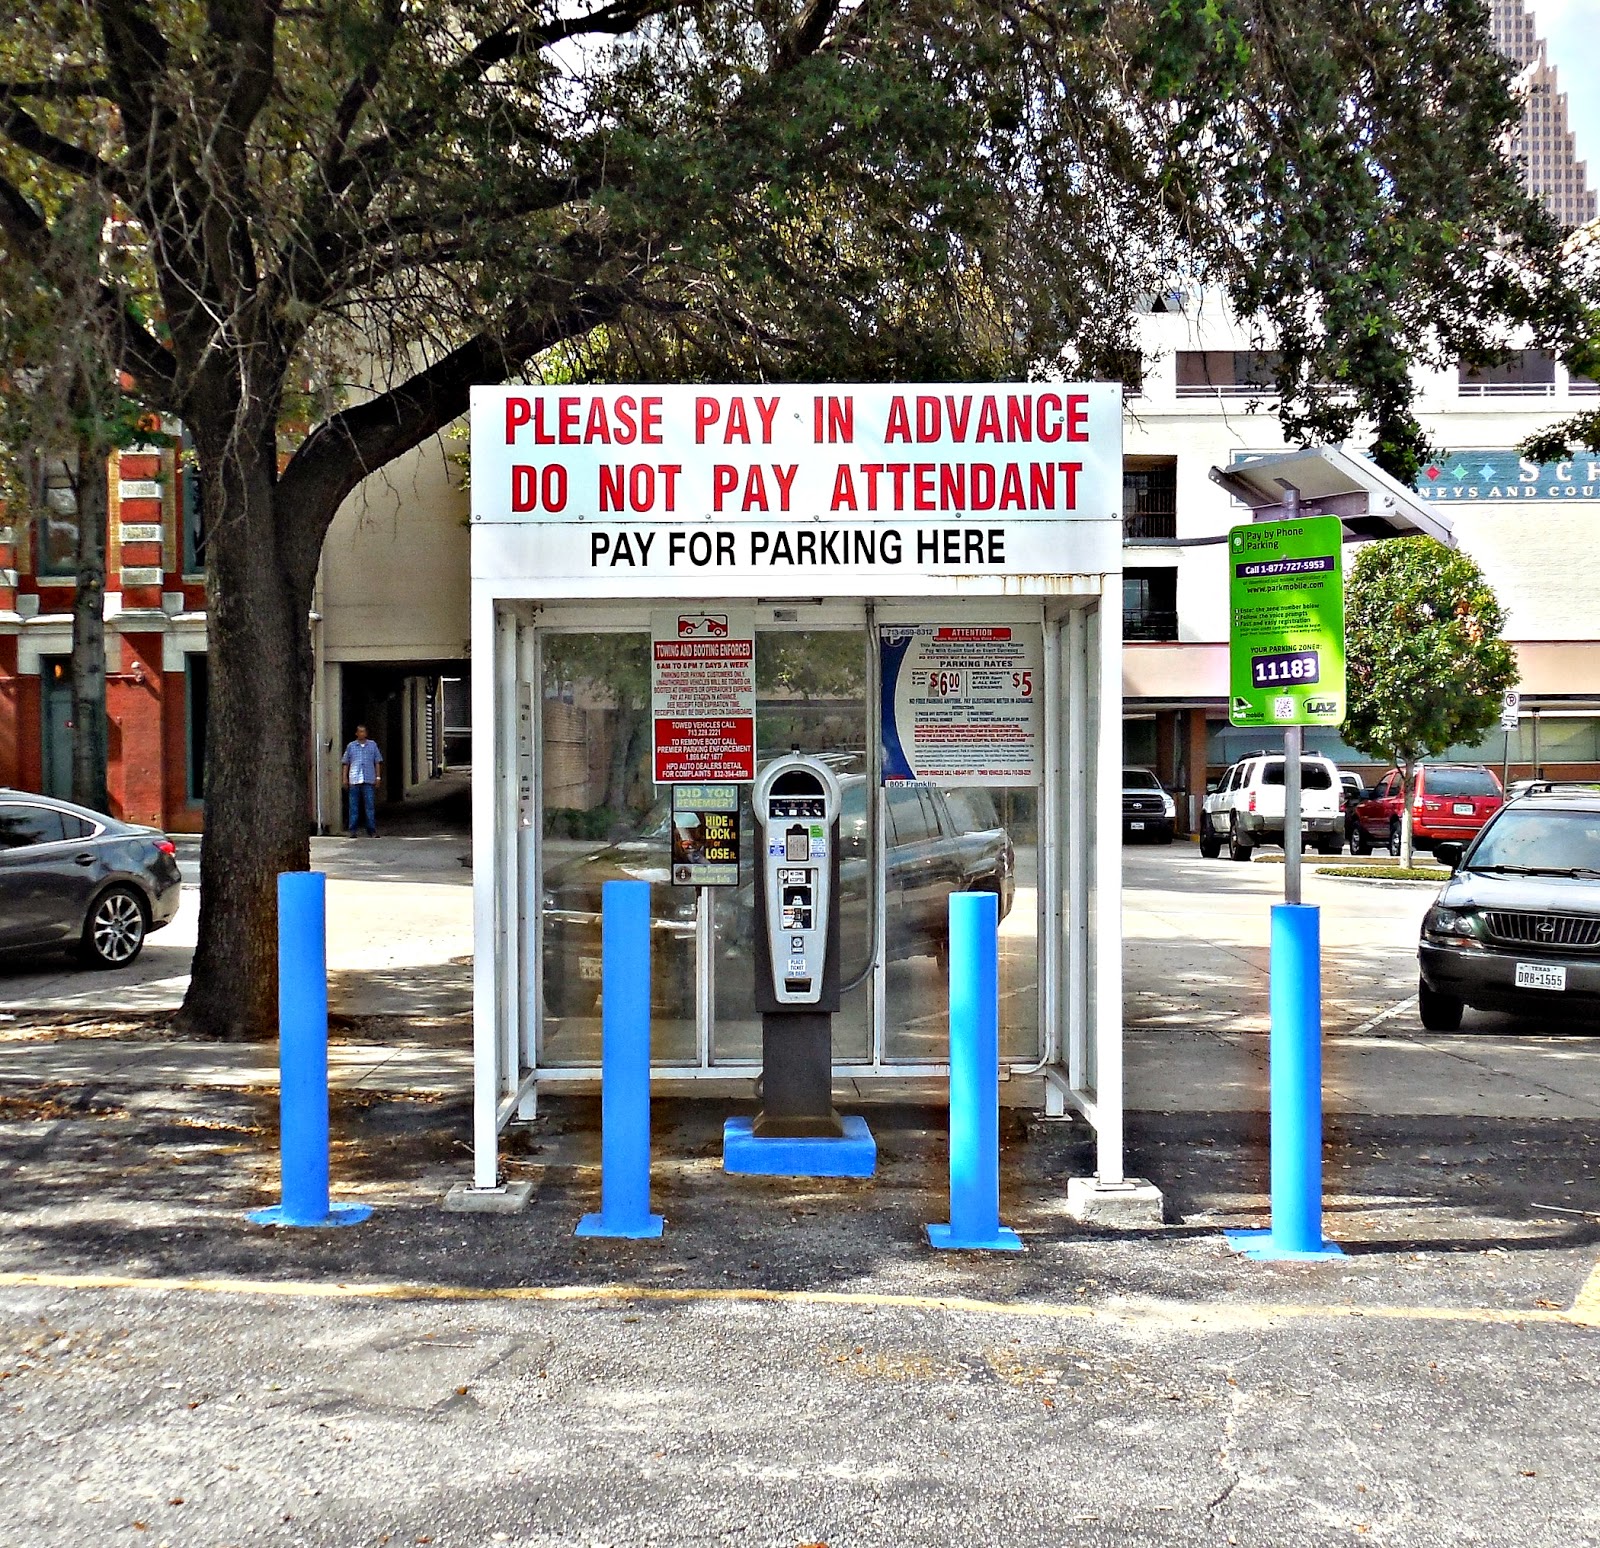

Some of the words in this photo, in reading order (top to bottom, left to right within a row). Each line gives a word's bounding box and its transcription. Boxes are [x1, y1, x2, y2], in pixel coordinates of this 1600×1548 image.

[505, 395, 664, 446] PLEASE
[694, 395, 781, 446] PAY
[813, 394, 855, 445] IN
[884, 393, 1090, 444] ADVANCE
[510, 463, 569, 513] DO
[598, 463, 682, 513] NOT
[712, 462, 799, 513] PAY
[829, 461, 1084, 513] ATTENDANT
[1488, 486, 1537, 498] AND
[1246, 531, 1262, 540] Pay
[1264, 530, 1274, 540] by
[1276, 528, 1304, 536] Phone
[590, 530, 664, 568] PAY
[668, 529, 736, 568] FOR
[750, 528, 902, 567] PARKING
[917, 527, 1007, 565] HERE
[1246, 541, 1279, 550] Parking
[1245, 566, 1260, 574] Call
[1261, 560, 1325, 573] 1-877-727-5953
[1247, 582, 1324, 593] www.parkmobile.com
[656, 644, 679, 657] TOWING
[680, 644, 692, 657] AND
[693, 644, 719, 657] BOOTING
[720, 643, 750, 656] ENFORCED
[1256, 658, 1316, 681] 11183
[1012, 672, 1032, 696] $5
[1307, 702, 1336, 714] LAZ
[676, 788, 701, 798] DID
[706, 788, 734, 798] YOU
[676, 798, 734, 808] REMEMBER?
[705, 816, 728, 827] HIDE
[705, 829, 730, 840] LOCK
[705, 848, 730, 859] LOSE
